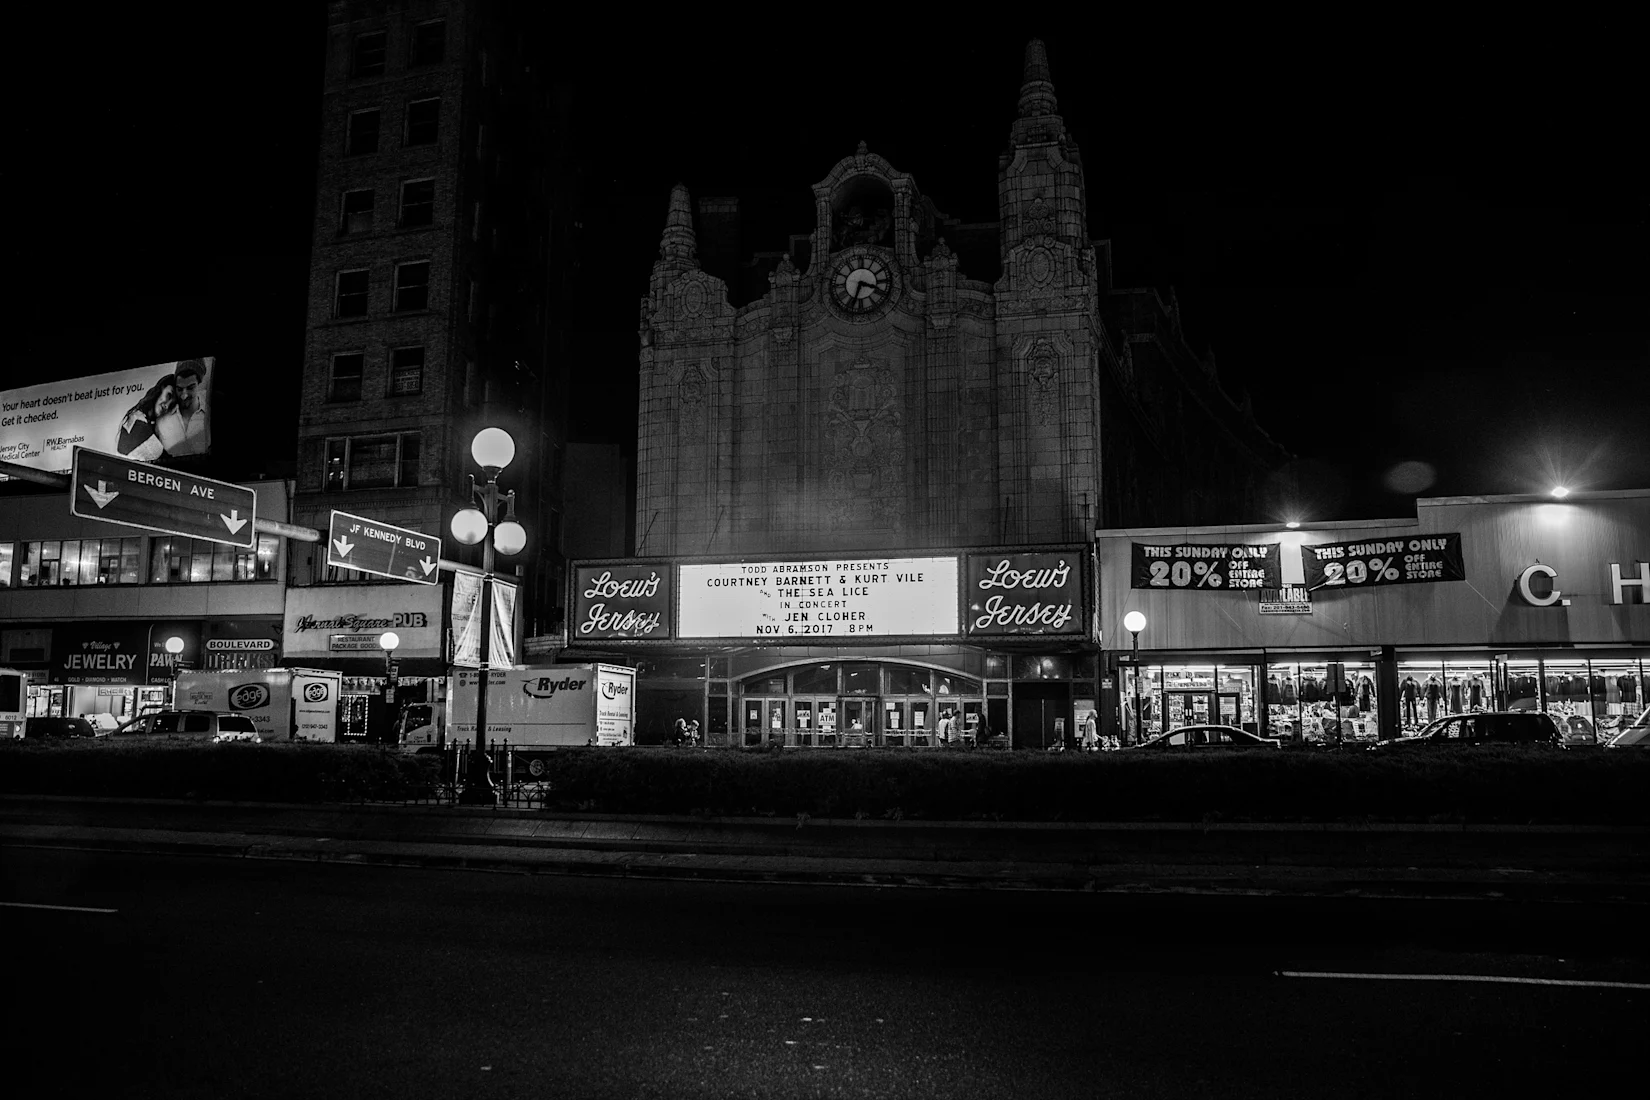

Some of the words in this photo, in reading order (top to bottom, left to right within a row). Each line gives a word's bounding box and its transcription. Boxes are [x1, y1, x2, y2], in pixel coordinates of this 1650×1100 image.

[2, 402, 19, 412] Your
[20, 399, 40, 410] heart
[42, 393, 72, 406] doesn't
[74, 390, 92, 400] beat
[94, 387, 110, 400] just
[112, 385, 124, 396] for
[126, 383, 144, 395] you.
[2, 416, 14, 427] Get
[16, 415, 22, 424] it
[24, 410, 58, 424] checked.
[18, 442, 30, 452] City
[21, 450, 40, 458] Center
[128, 470, 181, 492] BERGEN
[190, 485, 214, 500] AVE
[350, 524, 361, 534] JF
[364, 526, 402, 544] KENNEDY
[405, 538, 426, 551] BLVD
[1144, 546, 1172, 558] THIS
[1175, 546, 1228, 558] SUNDAY
[1232, 546, 1268, 559] ONLY
[1314, 546, 1345, 560] THIS
[1348, 541, 1404, 557] SUNDAY
[1408, 538, 1447, 552] ONLY
[1228, 560, 1249, 570] OFF
[1404, 554, 1426, 563] OFF
[742, 566, 767, 574] TODD
[773, 564, 828, 572] ABRAMSON
[836, 562, 889, 571] PRESENTS
[1323, 556, 1400, 586] 20%
[1405, 561, 1444, 571] ENTIRE
[707, 577, 768, 587] COURTNEY
[776, 576, 831, 586] BARNETT
[839, 575, 846, 584] &
[855, 574, 888, 584] KURT
[896, 573, 924, 582] VILE
[979, 560, 1070, 590] Loew's
[1150, 560, 1223, 588] 20%
[1228, 569, 1265, 579] ENTIRE
[1406, 570, 1442, 580] STORE
[584, 570, 660, 598] Loew's
[1228, 578, 1264, 588] STORE
[1520, 564, 1571, 607] C.
[760, 589, 771, 598] AND
[778, 588, 800, 598] THE
[810, 588, 834, 597] SEA
[842, 587, 869, 596] LICE
[798, 600, 847, 608] CONCERT
[580, 603, 660, 634] Jersey
[762, 613, 776, 622] WITH
[784, 612, 808, 622] JEN
[818, 612, 866, 621] CLOHER
[976, 595, 1072, 628] Jersey
[342, 614, 388, 632] Square
[392, 612, 427, 628] PUB
[756, 625, 780, 634] NOV
[90, 640, 112, 652] Village
[210, 640, 271, 648] BOULEVARD
[64, 654, 137, 670] JEWELRY
[150, 653, 184, 667] PAWN
[538, 677, 586, 694] Ryder
[608, 682, 628, 696] Ryder
